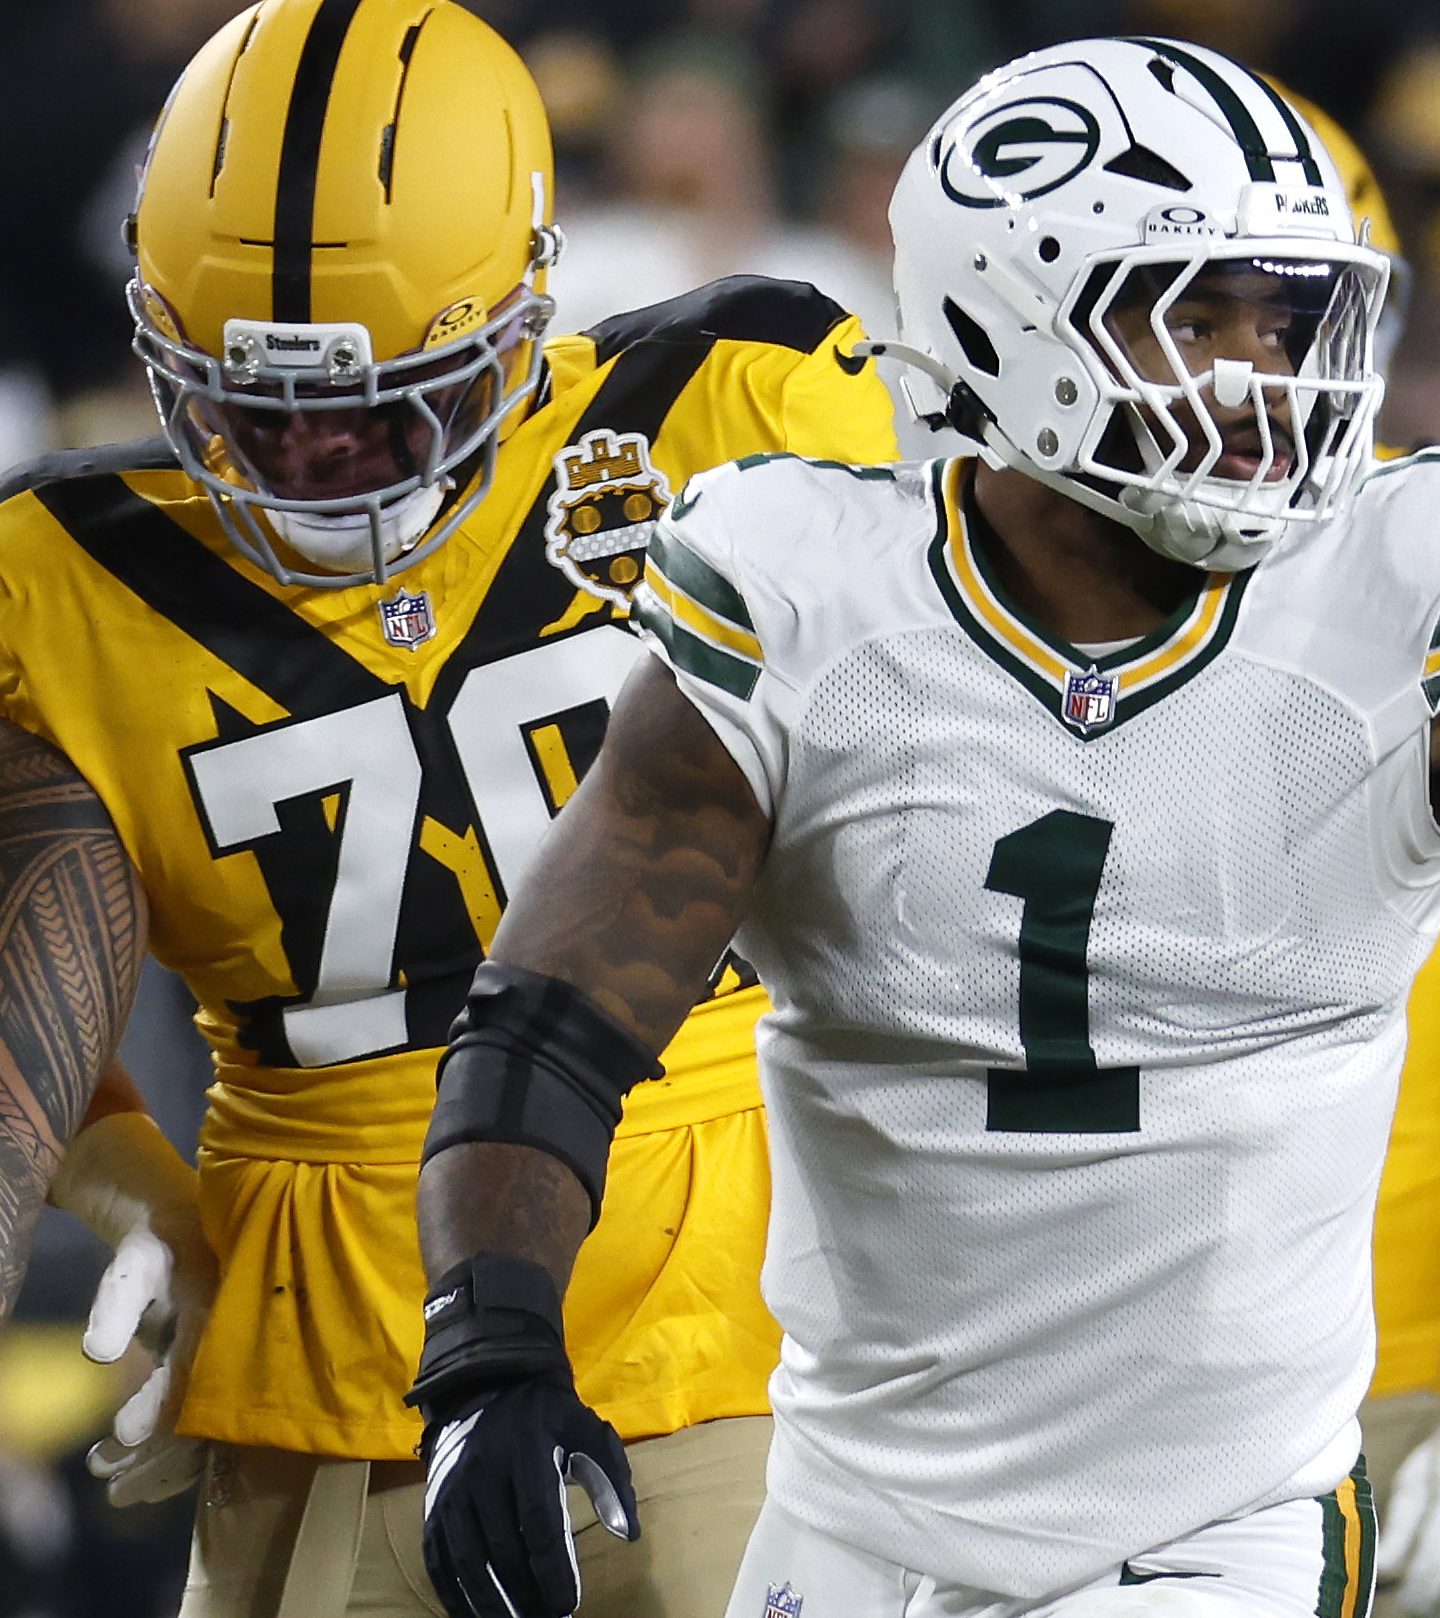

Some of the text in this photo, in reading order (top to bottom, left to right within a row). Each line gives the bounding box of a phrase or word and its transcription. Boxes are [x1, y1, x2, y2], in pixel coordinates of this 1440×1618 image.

[1149, 224, 1217, 236] OAKLEY
[430, 309, 482, 341] OAKLEY
[266, 334, 320, 351] Steelers
[391, 614, 427, 638] NFL
[1071, 694, 1106, 720] NFL
[984, 808, 1141, 1133] 1
